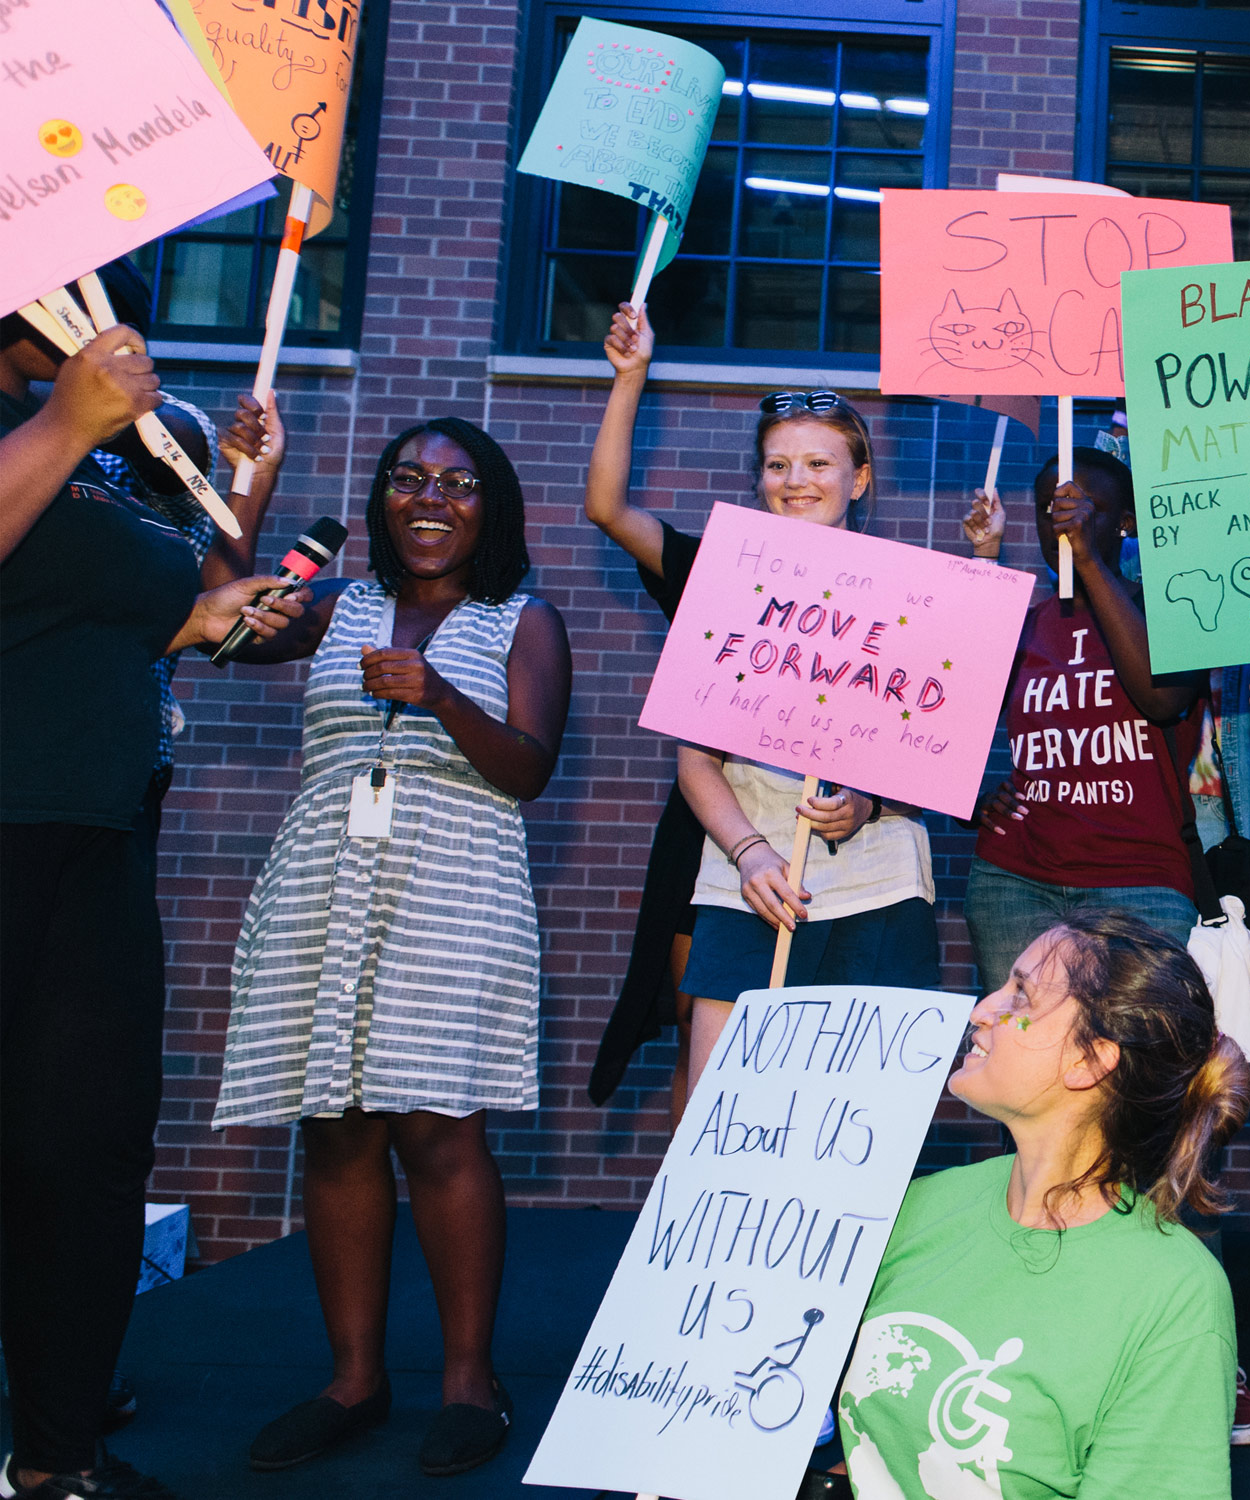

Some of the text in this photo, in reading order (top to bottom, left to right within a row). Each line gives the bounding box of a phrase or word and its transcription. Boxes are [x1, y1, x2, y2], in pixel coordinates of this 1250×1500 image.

[2, 51, 71, 88] the
[596, 50, 666, 85] OUR
[92, 96, 212, 165] Mandela
[584, 87, 686, 133] TO END
[580, 119, 620, 148] WE
[560, 143, 660, 186] ABOUT
[943, 210, 1187, 288] STOP
[186, 475, 208, 496] NYC
[1150, 489, 1221, 519] BLACK
[1153, 525, 1180, 548] BY
[737, 538, 934, 608] How can we
[996, 571, 1018, 584] 2016
[757, 596, 889, 656] MOVE
[1068, 628, 1088, 665] I
[714, 631, 946, 713] FORWARD
[1023, 669, 1114, 713] HATE
[694, 683, 949, 755] if half of us are held
[758, 729, 844, 762] back?
[1058, 779, 1134, 805] PANTS)
[717, 998, 945, 1073] NOTHING
[690, 1090, 874, 1166] About US
[648, 1175, 890, 1287] WITHOUT
[678, 1281, 754, 1340] US
